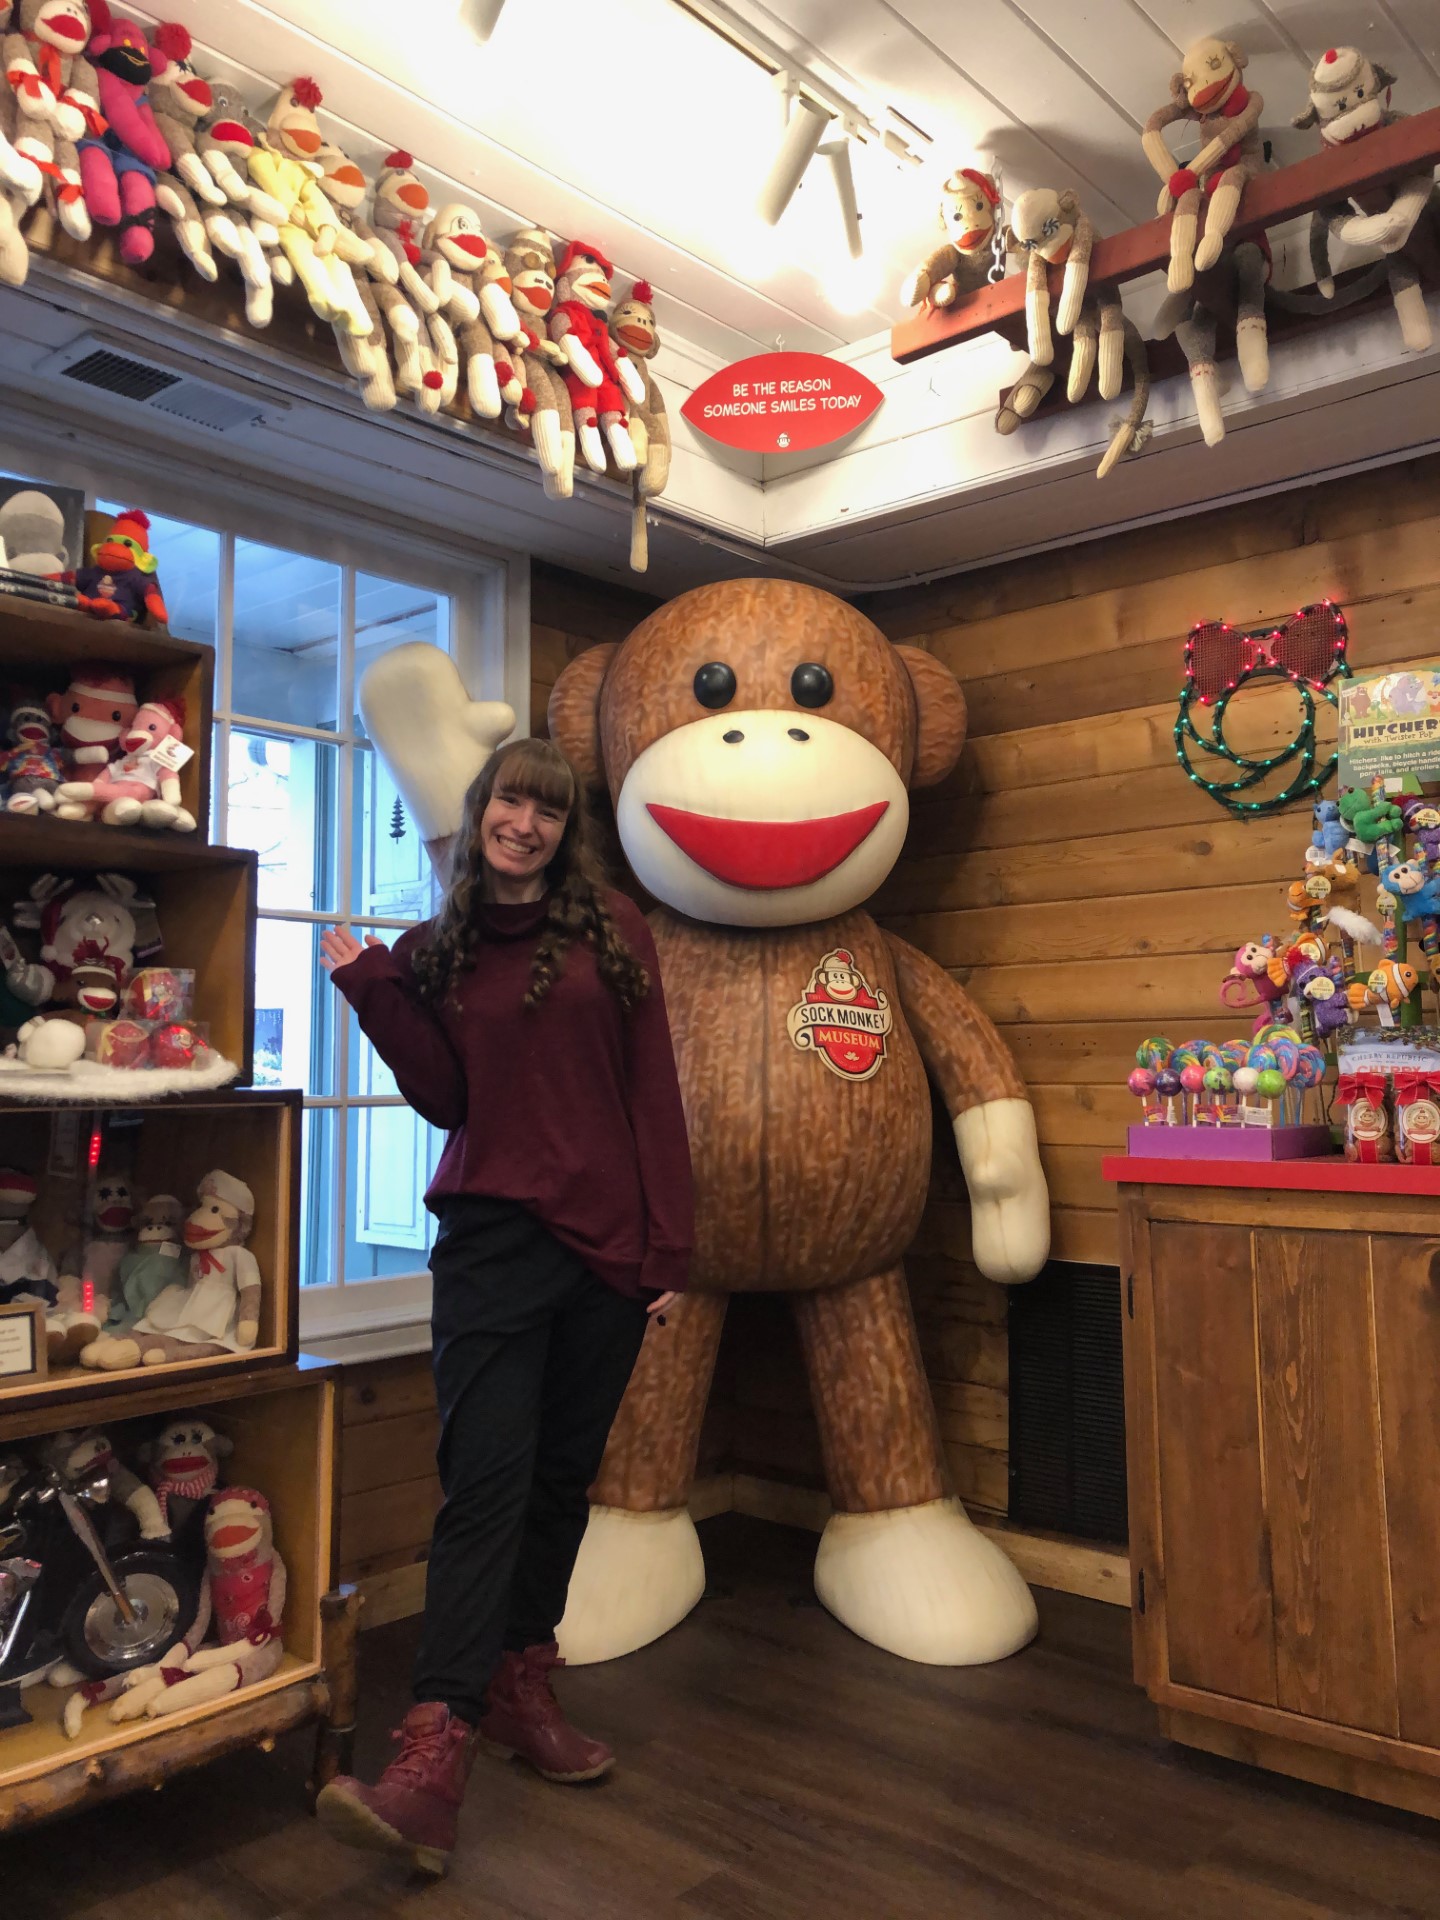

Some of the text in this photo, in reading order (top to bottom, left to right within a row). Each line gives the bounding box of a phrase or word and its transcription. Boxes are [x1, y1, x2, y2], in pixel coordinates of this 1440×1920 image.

[732, 378, 832, 397] BE THE REASON
[703, 394, 862, 418] SOMEONE SMILES TODAY
[1353, 718, 1440, 740] HITCHER
[1364, 736, 1382, 744] with
[1384, 732, 1416, 742] Twister
[1403, 751, 1420, 759] hitch
[801, 1006, 885, 1030] SOCK MONKEY
[818, 1030, 881, 1049] MUSEUM
